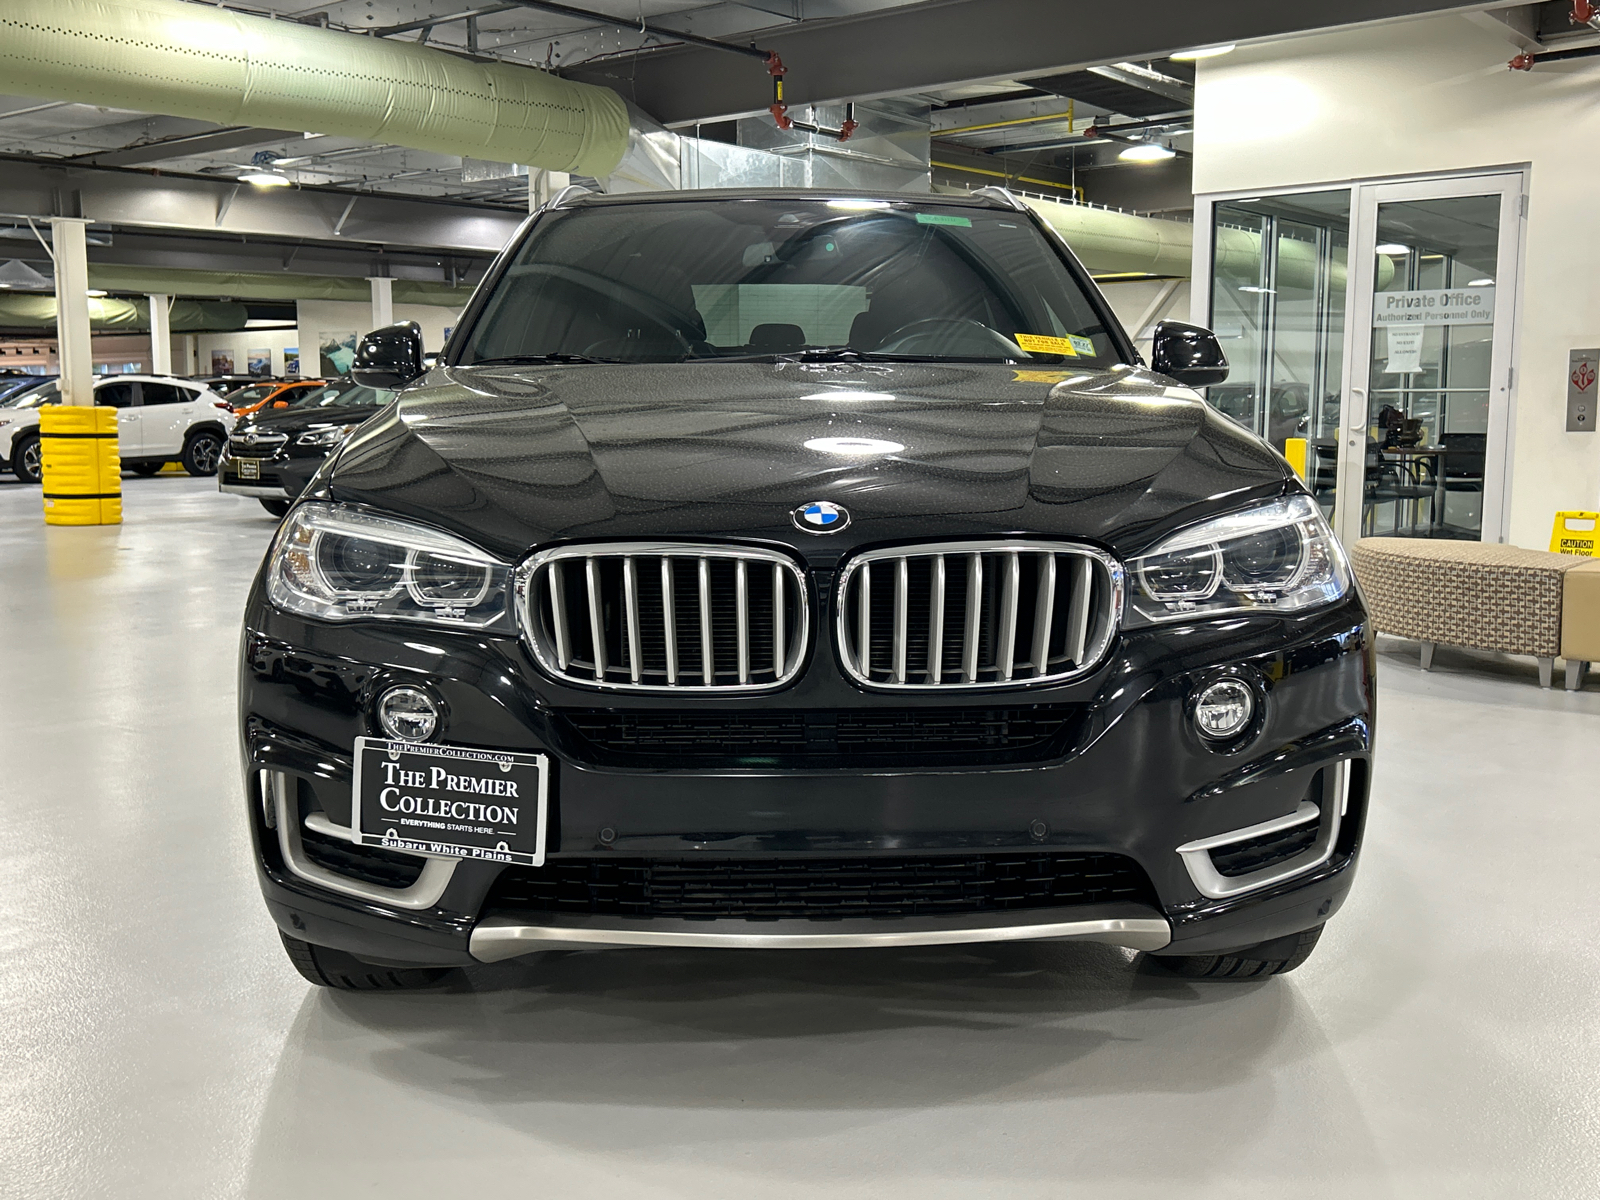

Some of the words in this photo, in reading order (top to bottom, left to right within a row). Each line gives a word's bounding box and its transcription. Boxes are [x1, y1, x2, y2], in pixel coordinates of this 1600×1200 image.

[1387, 295, 1435, 309] Private
[1440, 293, 1481, 306] Office
[1376, 312, 1422, 322] Authorized
[1425, 310, 1468, 320] Personnel
[1471, 309, 1491, 320] Only
[1561, 540, 1593, 548] CAUTION
[381, 761, 426, 788] THE
[429, 766, 519, 798] PREMIER
[379, 787, 519, 825] COLLECTION
[400, 818, 446, 829] EVERYTHING
[446, 823, 473, 833] STARTS
[381, 838, 426, 851] Subaru
[430, 843, 468, 856] White
[472, 849, 512, 862] Plains
